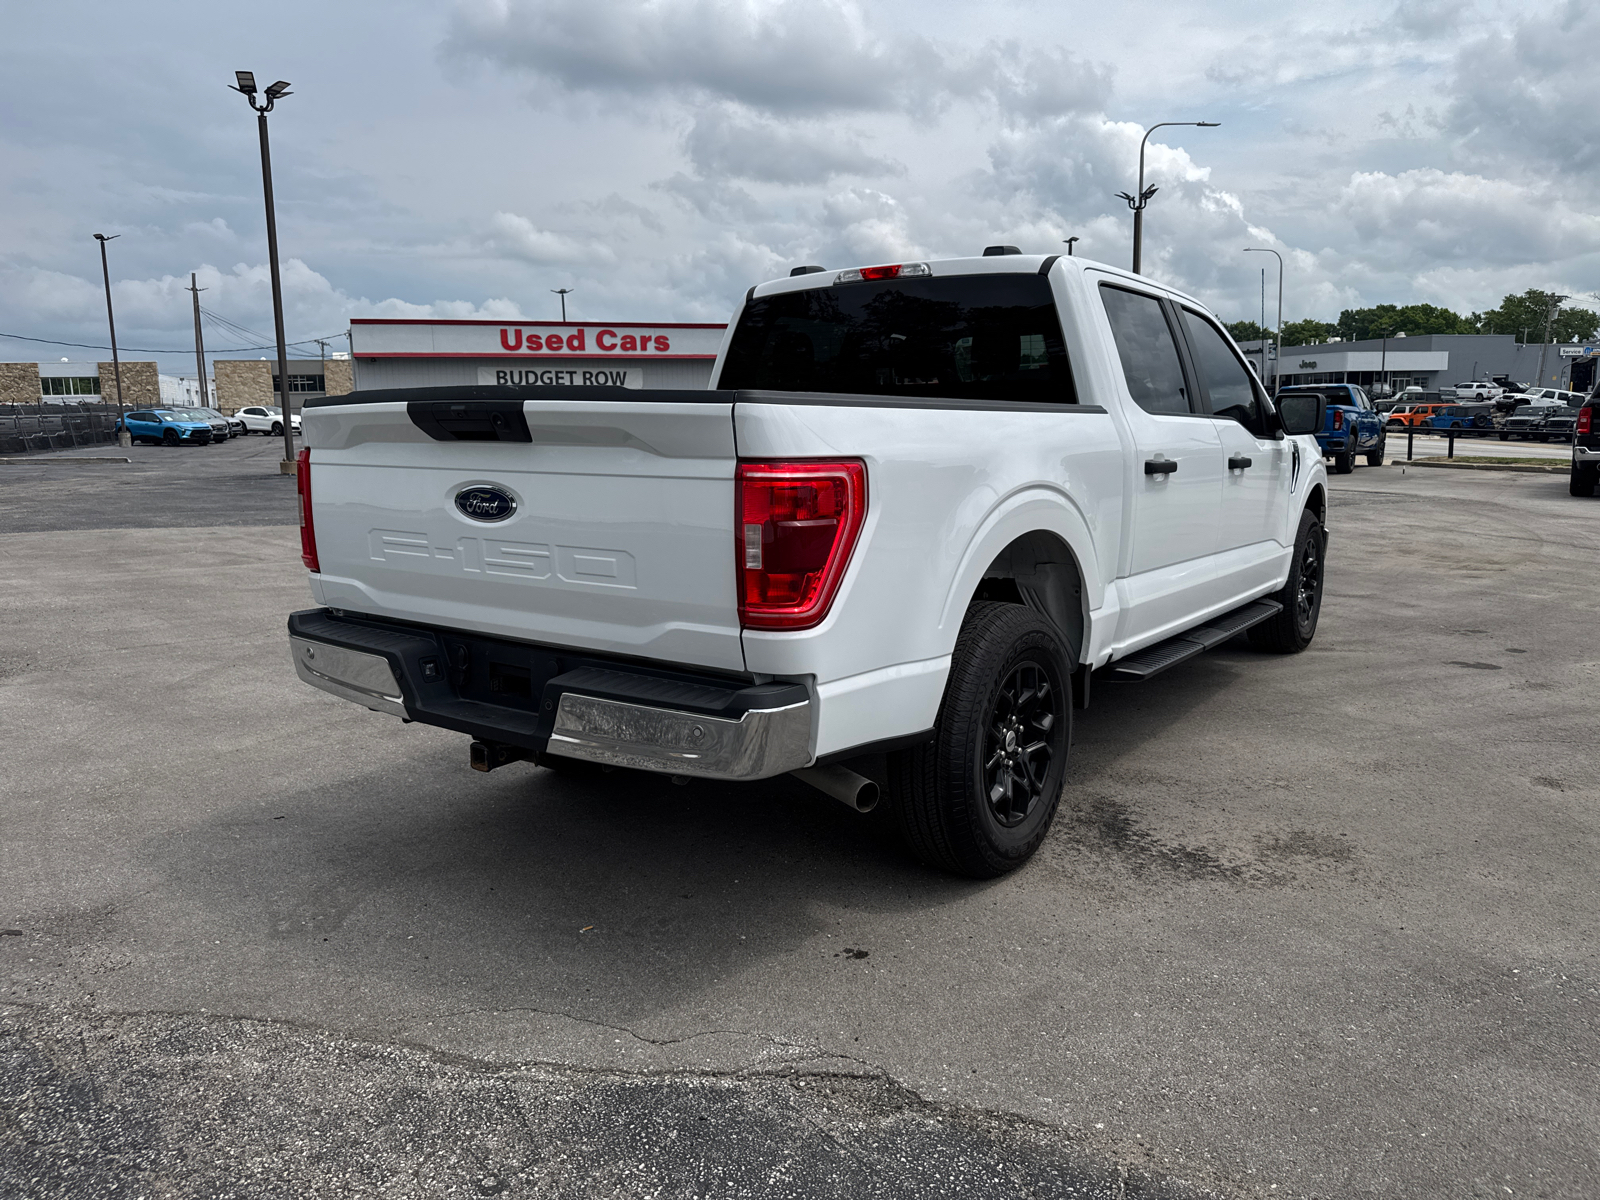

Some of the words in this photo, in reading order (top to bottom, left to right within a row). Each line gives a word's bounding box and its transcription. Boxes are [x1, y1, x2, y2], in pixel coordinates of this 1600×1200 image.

[500, 328, 585, 352] Used
[595, 328, 671, 352] Cars
[1298, 359, 1317, 370] Jeep
[496, 369, 577, 387] BUDGET
[582, 370, 627, 387] ROW
[467, 491, 500, 515] Ford
[367, 527, 638, 590] F-150
